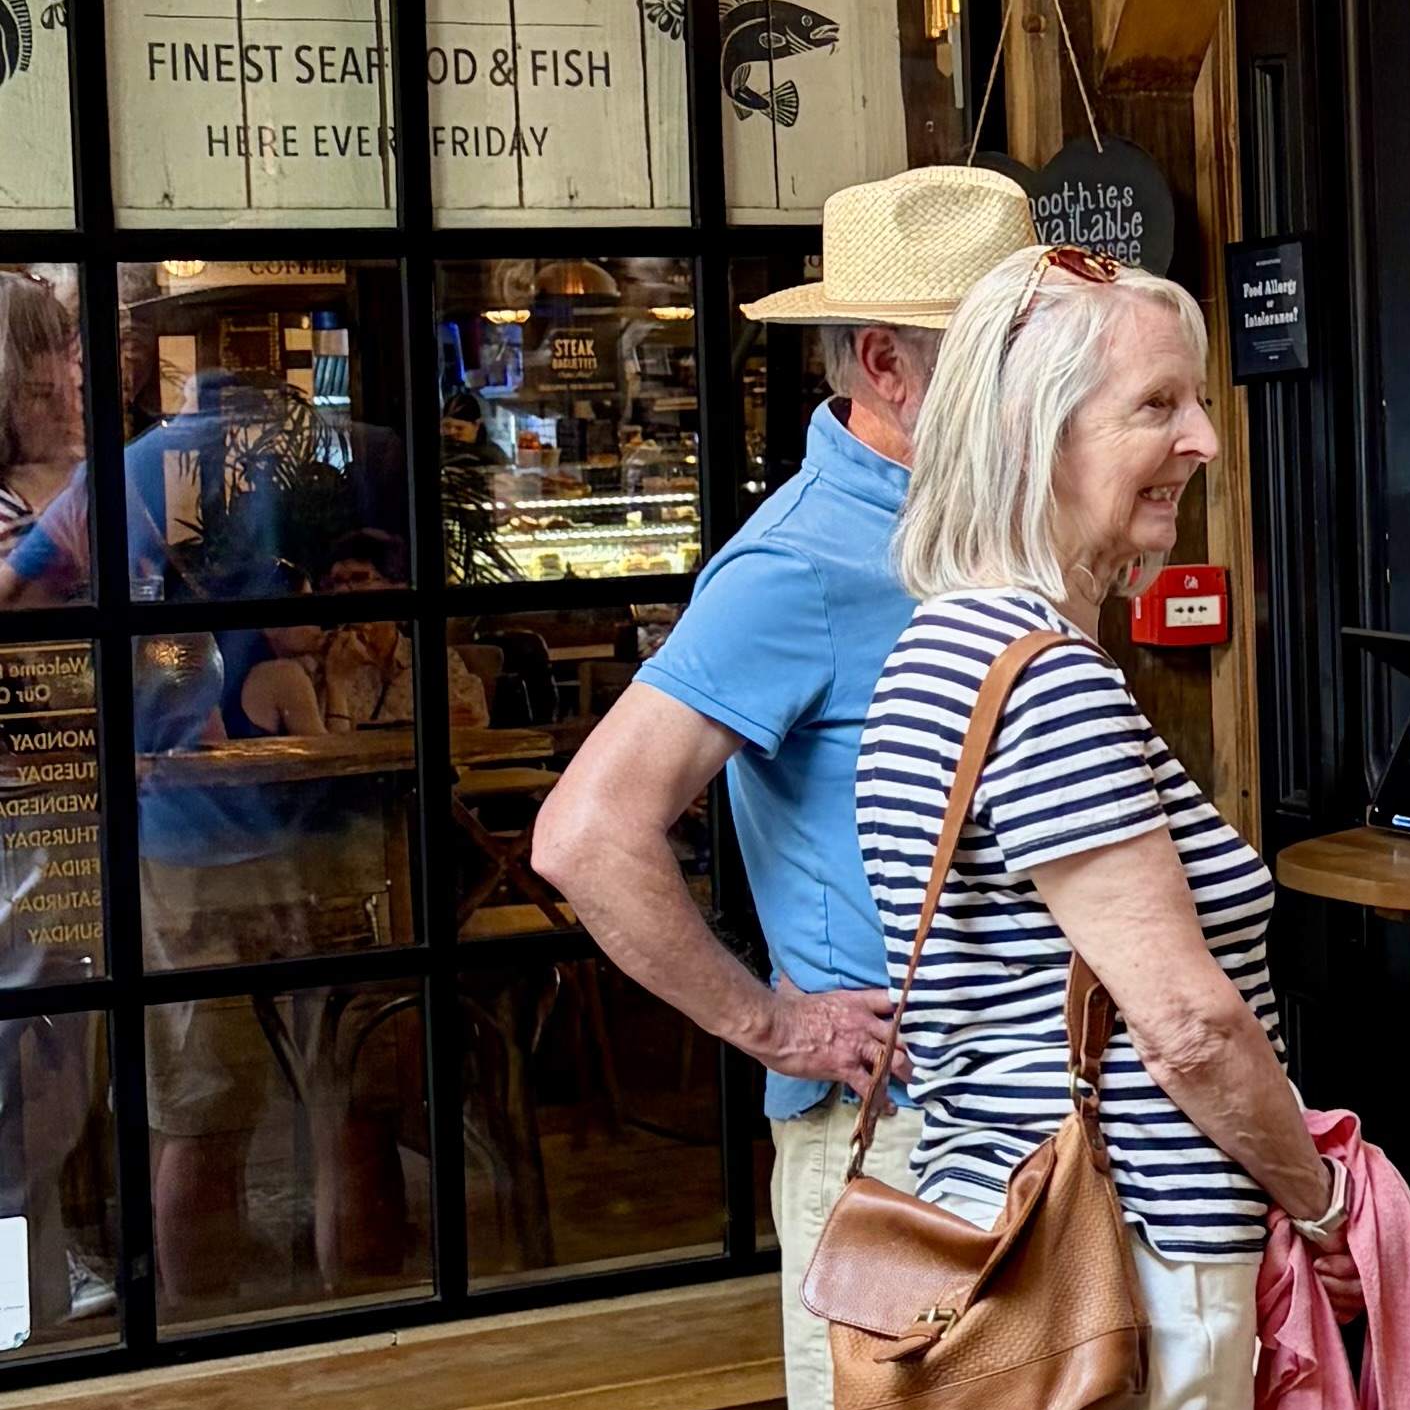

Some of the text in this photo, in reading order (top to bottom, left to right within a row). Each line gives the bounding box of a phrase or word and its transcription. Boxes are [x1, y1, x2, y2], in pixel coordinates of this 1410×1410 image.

[148, 42, 612, 88] FINEST SEAFOD & FISH
[206, 125, 549, 159] HERE EVER FRIDAY
[1028, 181, 1134, 220] oothies
[1035, 200, 1144, 246] vailable
[1242, 278, 1297, 298] Food Allergy
[1244, 306, 1299, 329] Intolerance?
[553, 338, 596, 358] STEAK
